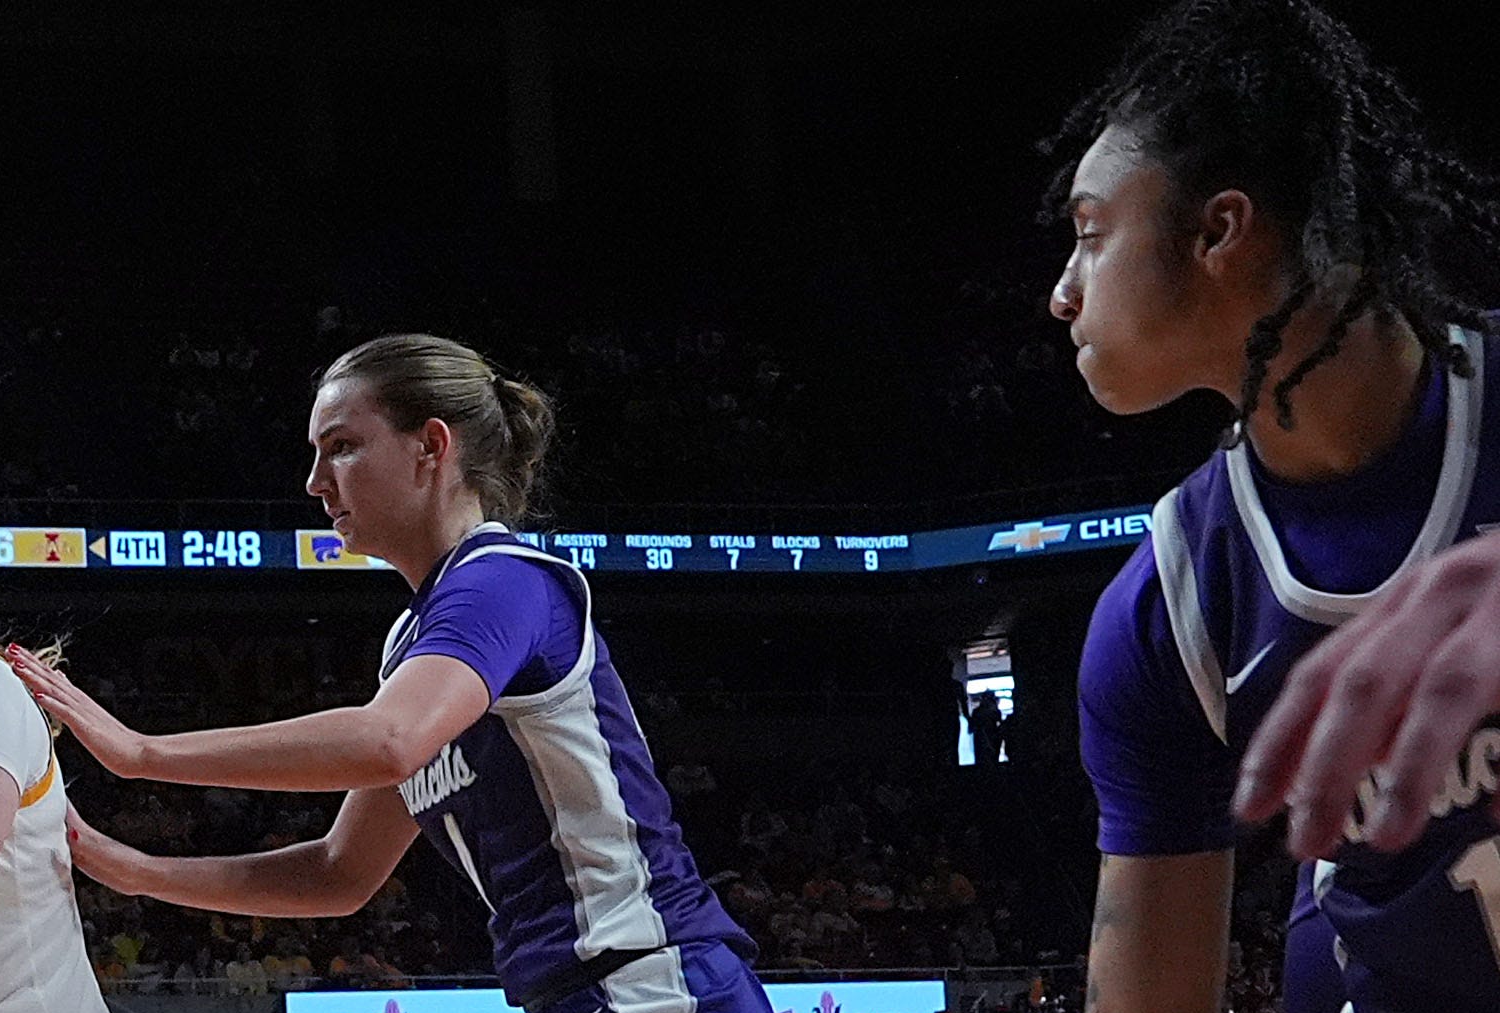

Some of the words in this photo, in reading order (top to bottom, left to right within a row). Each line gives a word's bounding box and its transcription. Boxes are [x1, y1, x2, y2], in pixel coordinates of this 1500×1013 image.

[116, 538, 159, 560] 4TH
[182, 530, 261, 567] 2:48
[554, 534, 607, 547] ASSISTS
[625, 535, 692, 548] REBOUNDS
[709, 536, 755, 549] STEALS
[772, 536, 820, 549] BLOCKS
[835, 535, 909, 549] TURNOVERS
[570, 548, 595, 569] 14
[646, 549, 673, 570] 30
[726, 549, 740, 570] 7
[790, 550, 803, 570] 7
[864, 550, 878, 571] 9
